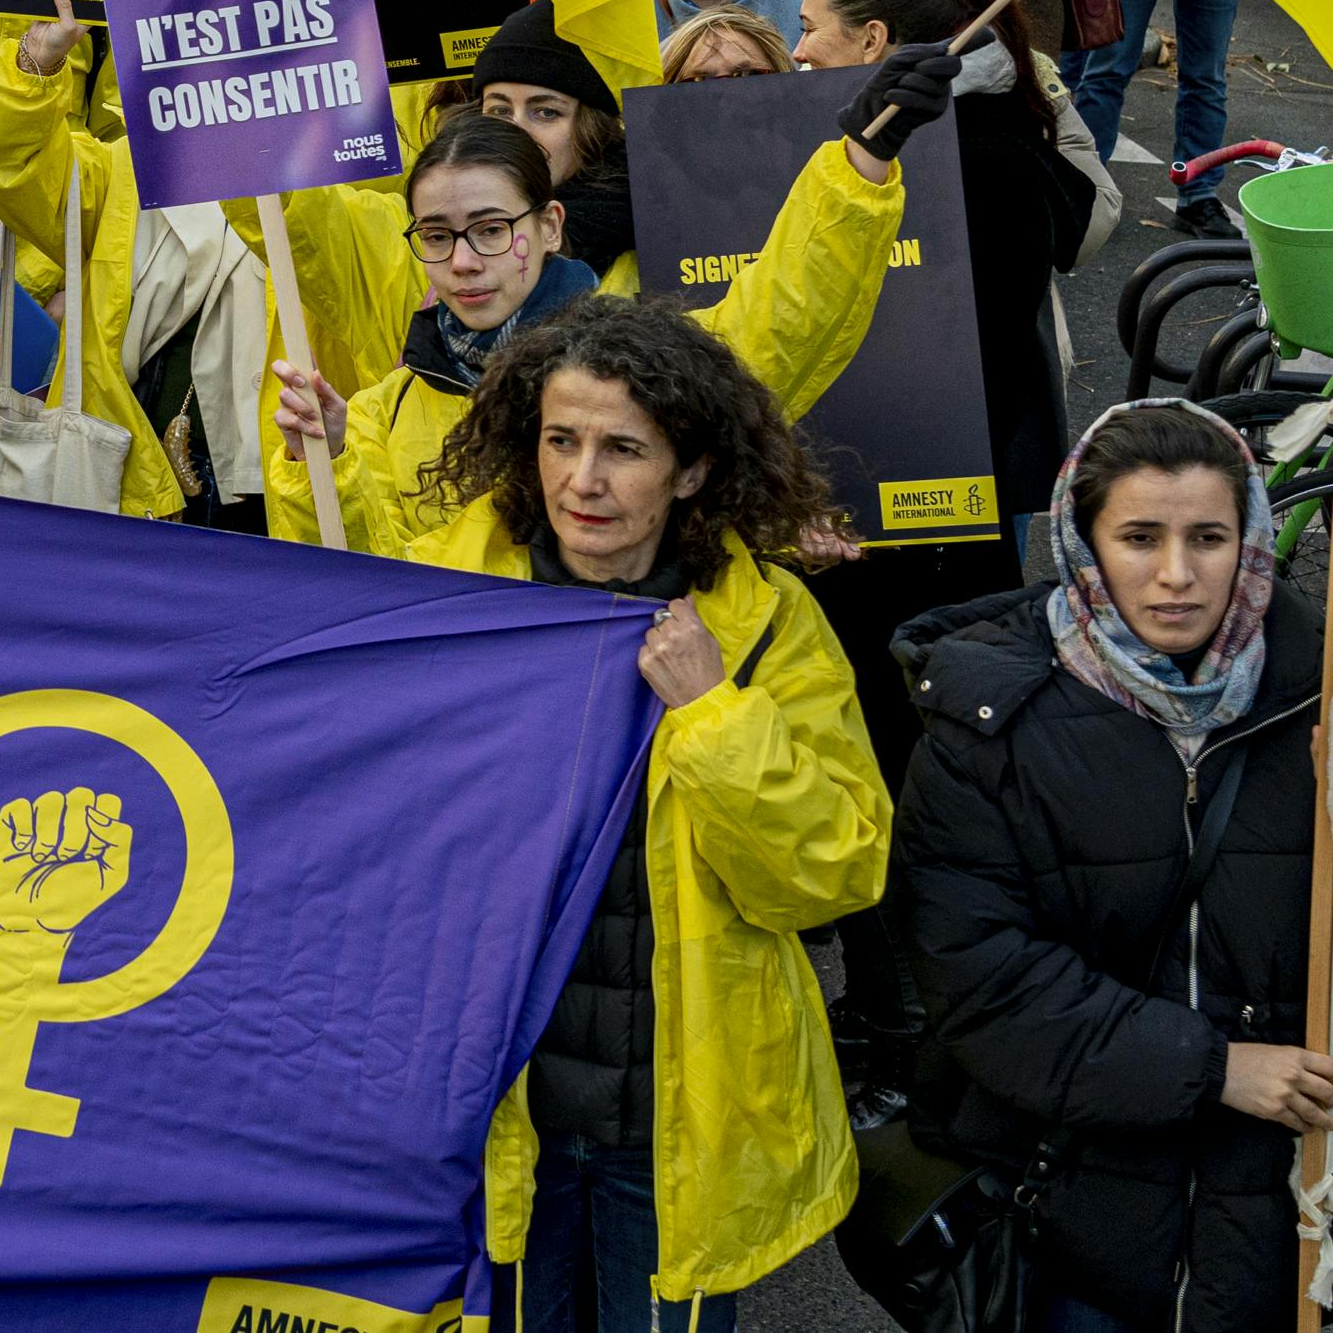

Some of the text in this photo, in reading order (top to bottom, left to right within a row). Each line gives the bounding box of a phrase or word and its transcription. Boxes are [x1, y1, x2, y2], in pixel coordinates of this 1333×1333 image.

[136, 6, 241, 64] N'EST
[149, 59, 362, 132] CONSENTIR
[343, 133, 383, 149] nous
[891, 488, 954, 508] AMNESTY
[893, 506, 956, 520] INTERNATIONAL
